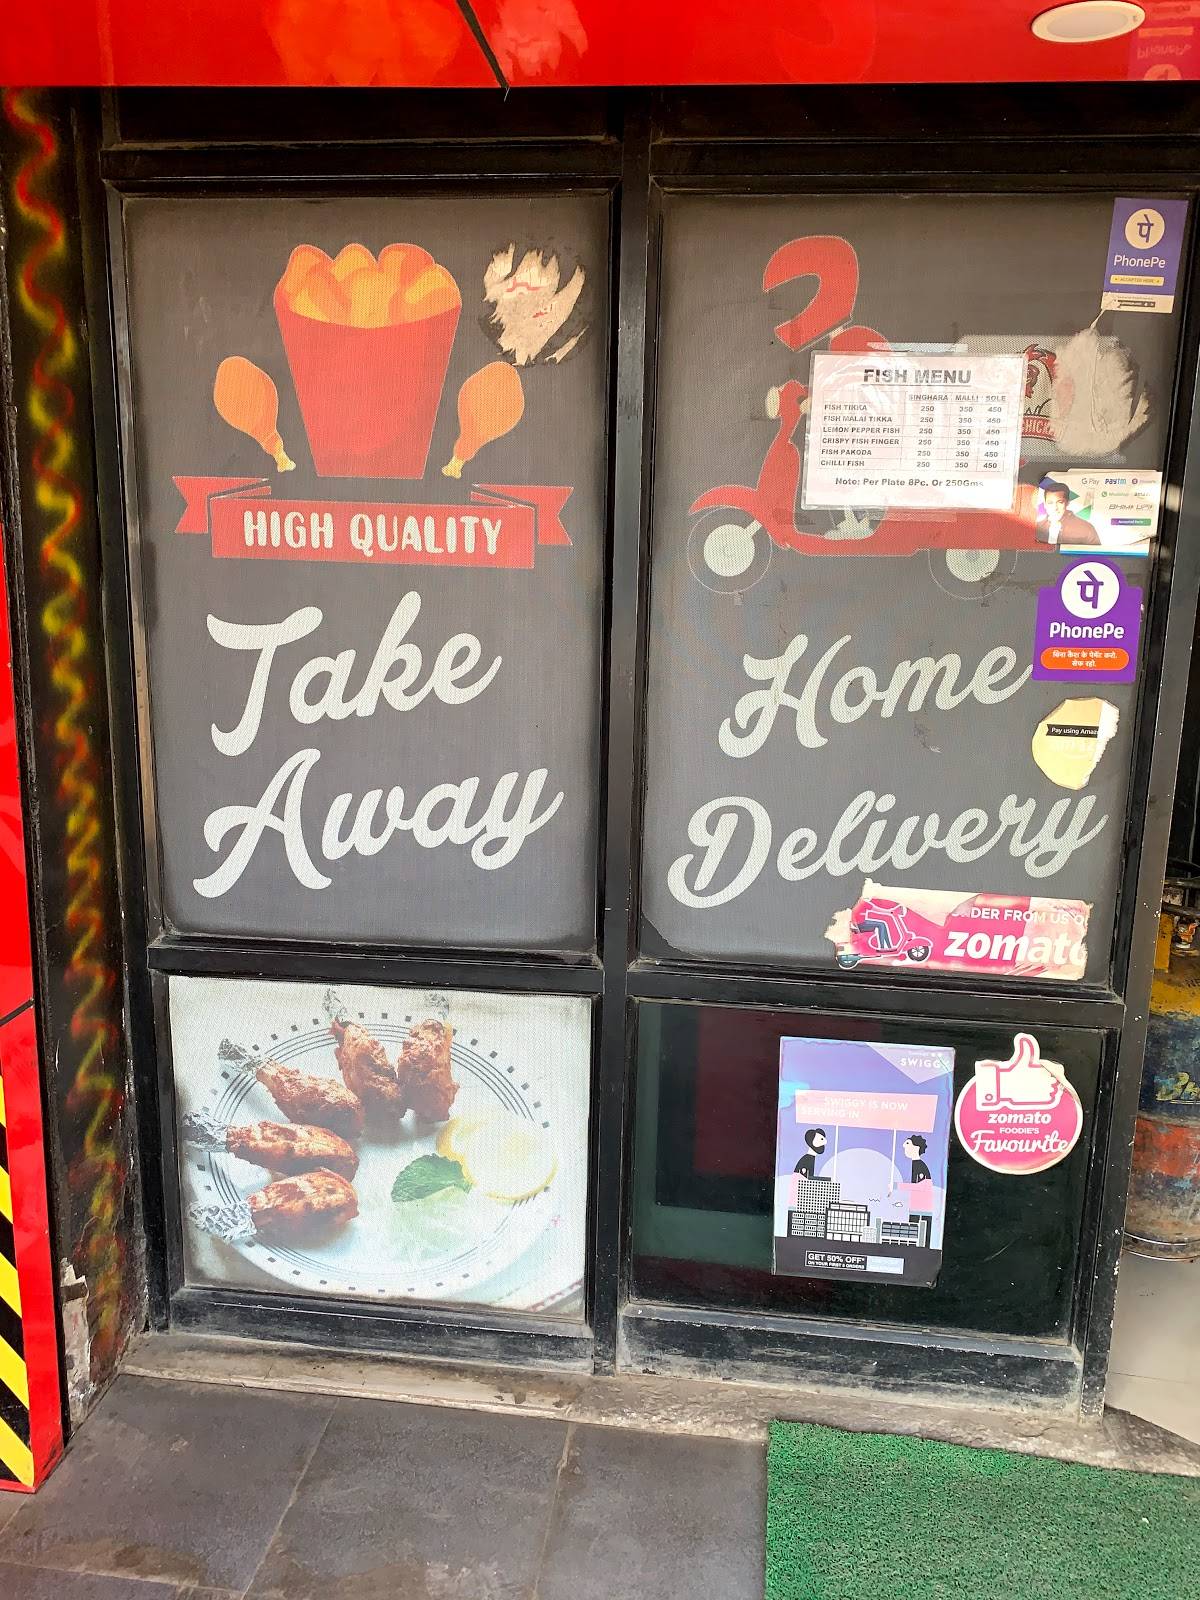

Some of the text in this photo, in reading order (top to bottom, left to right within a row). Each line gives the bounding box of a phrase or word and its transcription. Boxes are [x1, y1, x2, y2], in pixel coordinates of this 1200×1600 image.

[1113, 254, 1166, 269] PhonePe
[863, 368, 972, 384] FISH MENU
[835, 477, 860, 486] Note:
[863, 478, 879, 486] Per
[881, 478, 906, 487] Plate
[908, 479, 929, 487] 8Pc.
[931, 479, 943, 487] Or
[242, 509, 502, 558] HIGH QUALITY
[1076, 570, 1104, 609] पे
[1049, 621, 1125, 640] PhonePe
[206, 590, 502, 757] Take
[718, 633, 1034, 758] Home
[1051, 727, 1062, 735] Pay
[1063, 728, 1080, 736] using
[192, 748, 564, 898] Away
[667, 790, 1109, 908] Delivery
[952, 907, 1000, 920] DER
[1003, 909, 1045, 922] FROM
[1050, 913, 1071, 924] US
[943, 931, 1088, 966] zomato
[880, 1101, 909, 1112] NOW
[988, 1112, 1052, 1125] zomato
[970, 1130, 1069, 1155] Favourite
[827, 1254, 843, 1262] 50%
